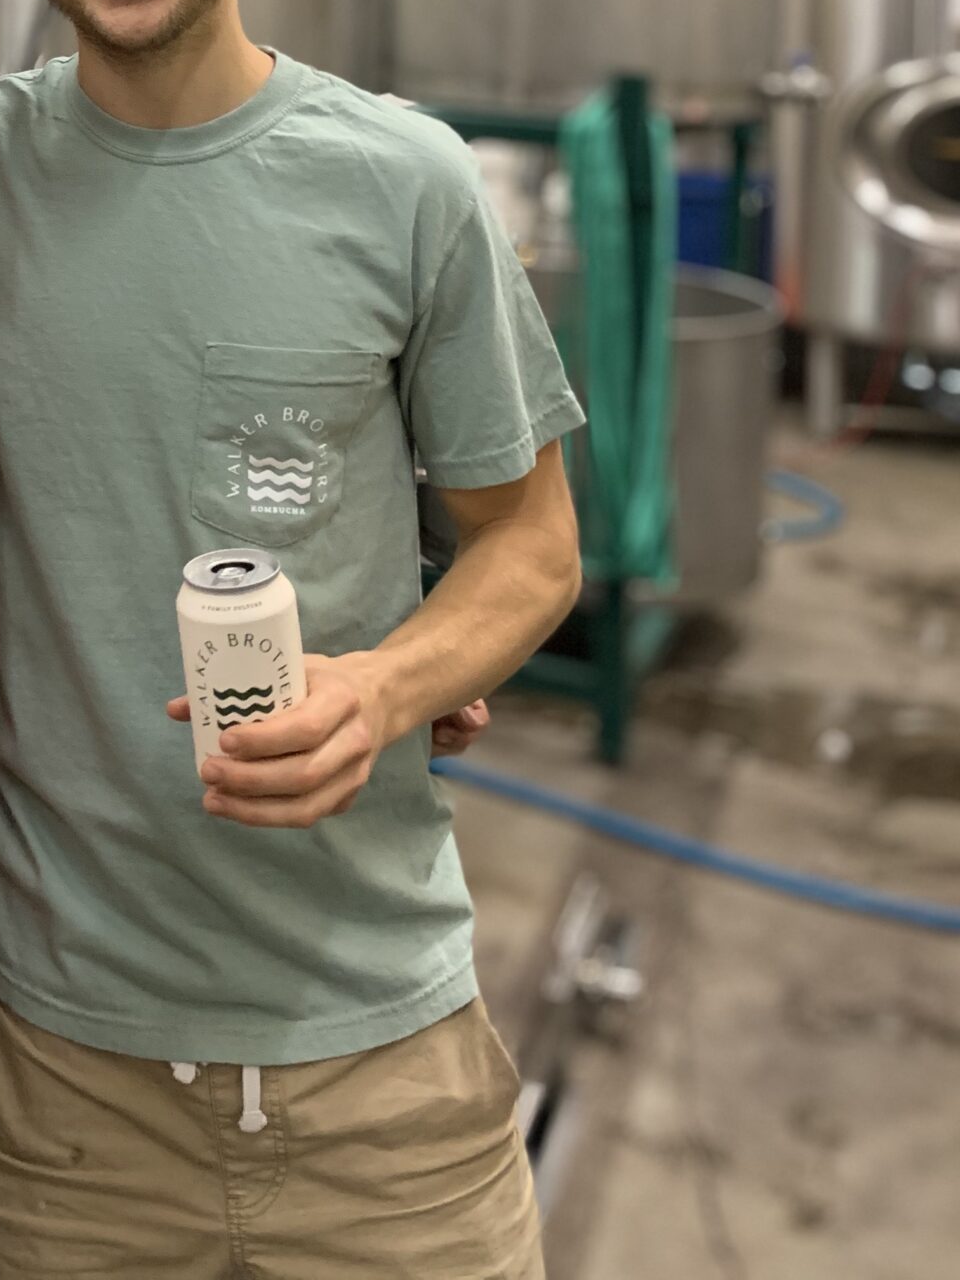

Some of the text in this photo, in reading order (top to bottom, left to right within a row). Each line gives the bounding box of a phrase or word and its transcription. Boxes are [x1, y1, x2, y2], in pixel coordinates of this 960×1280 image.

[226, 406, 328, 503] WALKER BROHRS
[250, 505, 306, 515] KOMBUCHA
[195, 633, 293, 727] WALKER BROTHER
